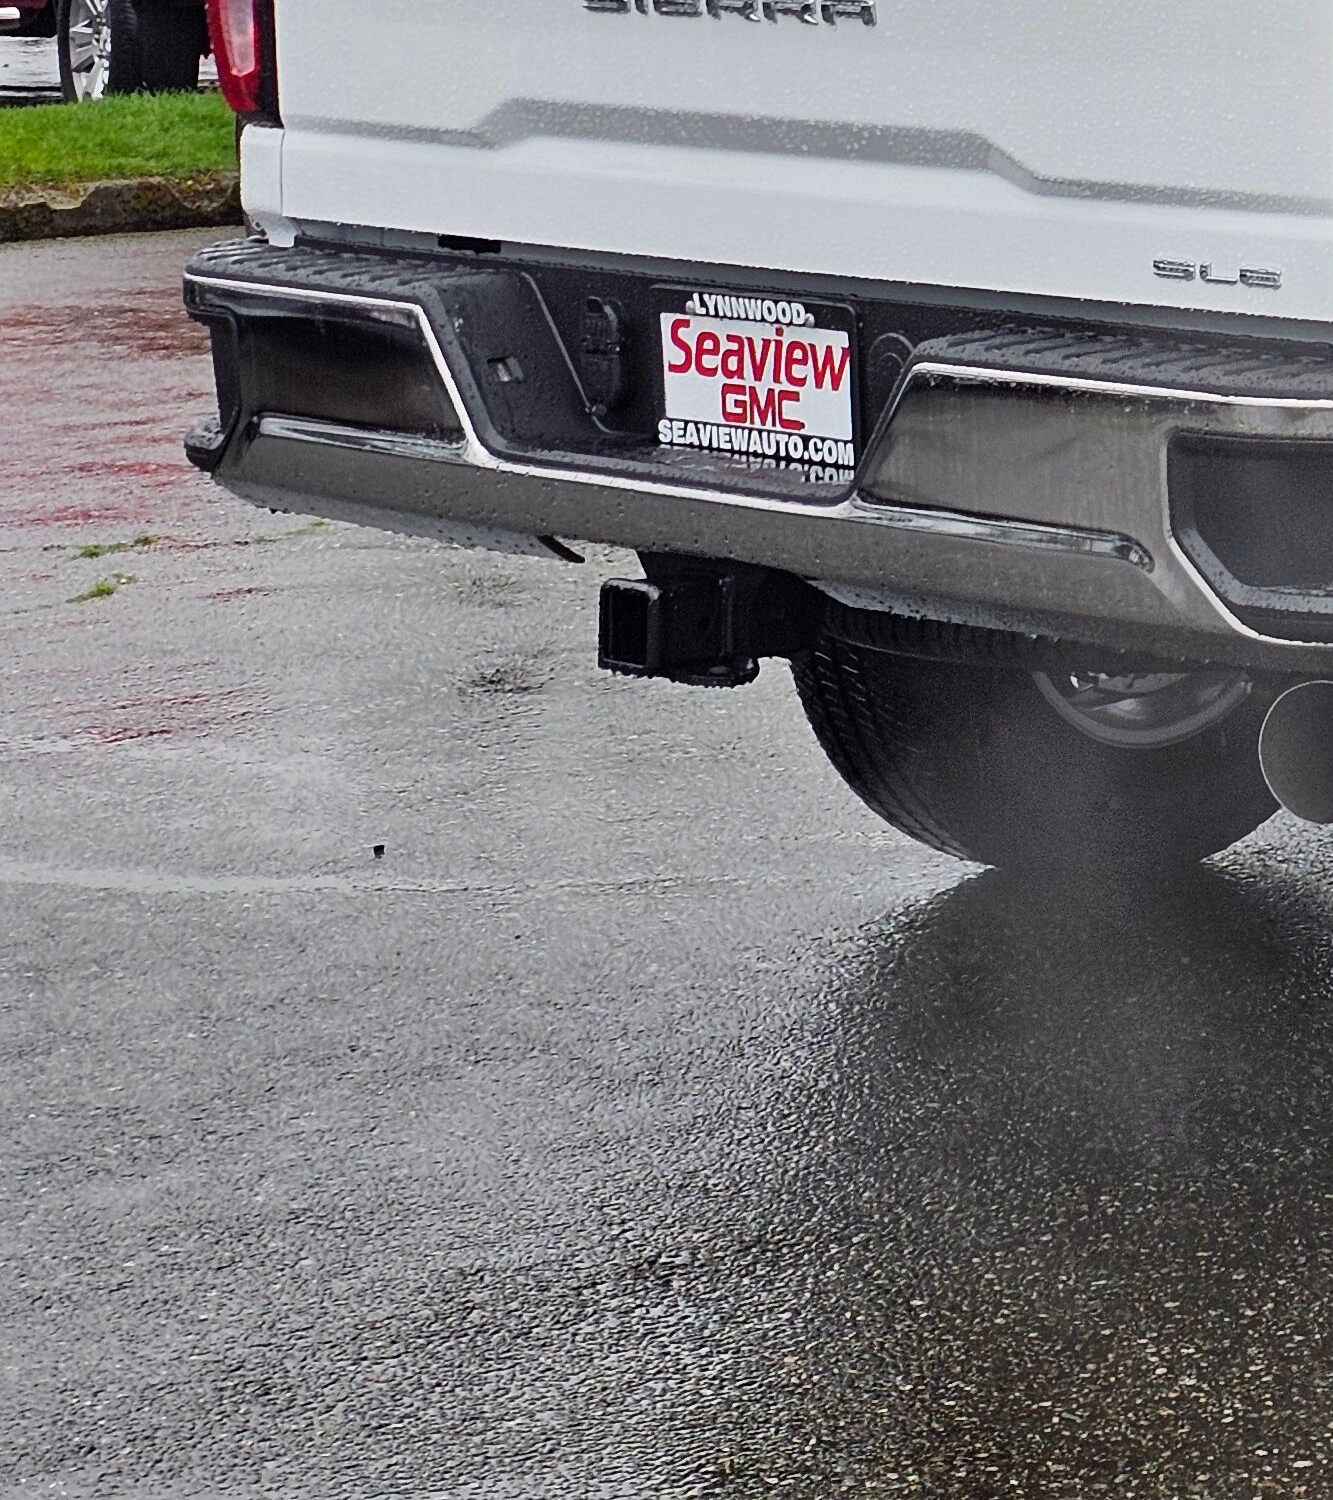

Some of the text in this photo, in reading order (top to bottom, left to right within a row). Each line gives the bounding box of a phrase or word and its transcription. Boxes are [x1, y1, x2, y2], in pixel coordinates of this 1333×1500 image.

[1152, 257, 1283, 291] SLE
[692, 292, 806, 326] LYNNWOOD
[668, 318, 849, 392] Seaview
[721, 382, 806, 431] GMC
[658, 419, 855, 467] SEAVIEWAUTO.COM
